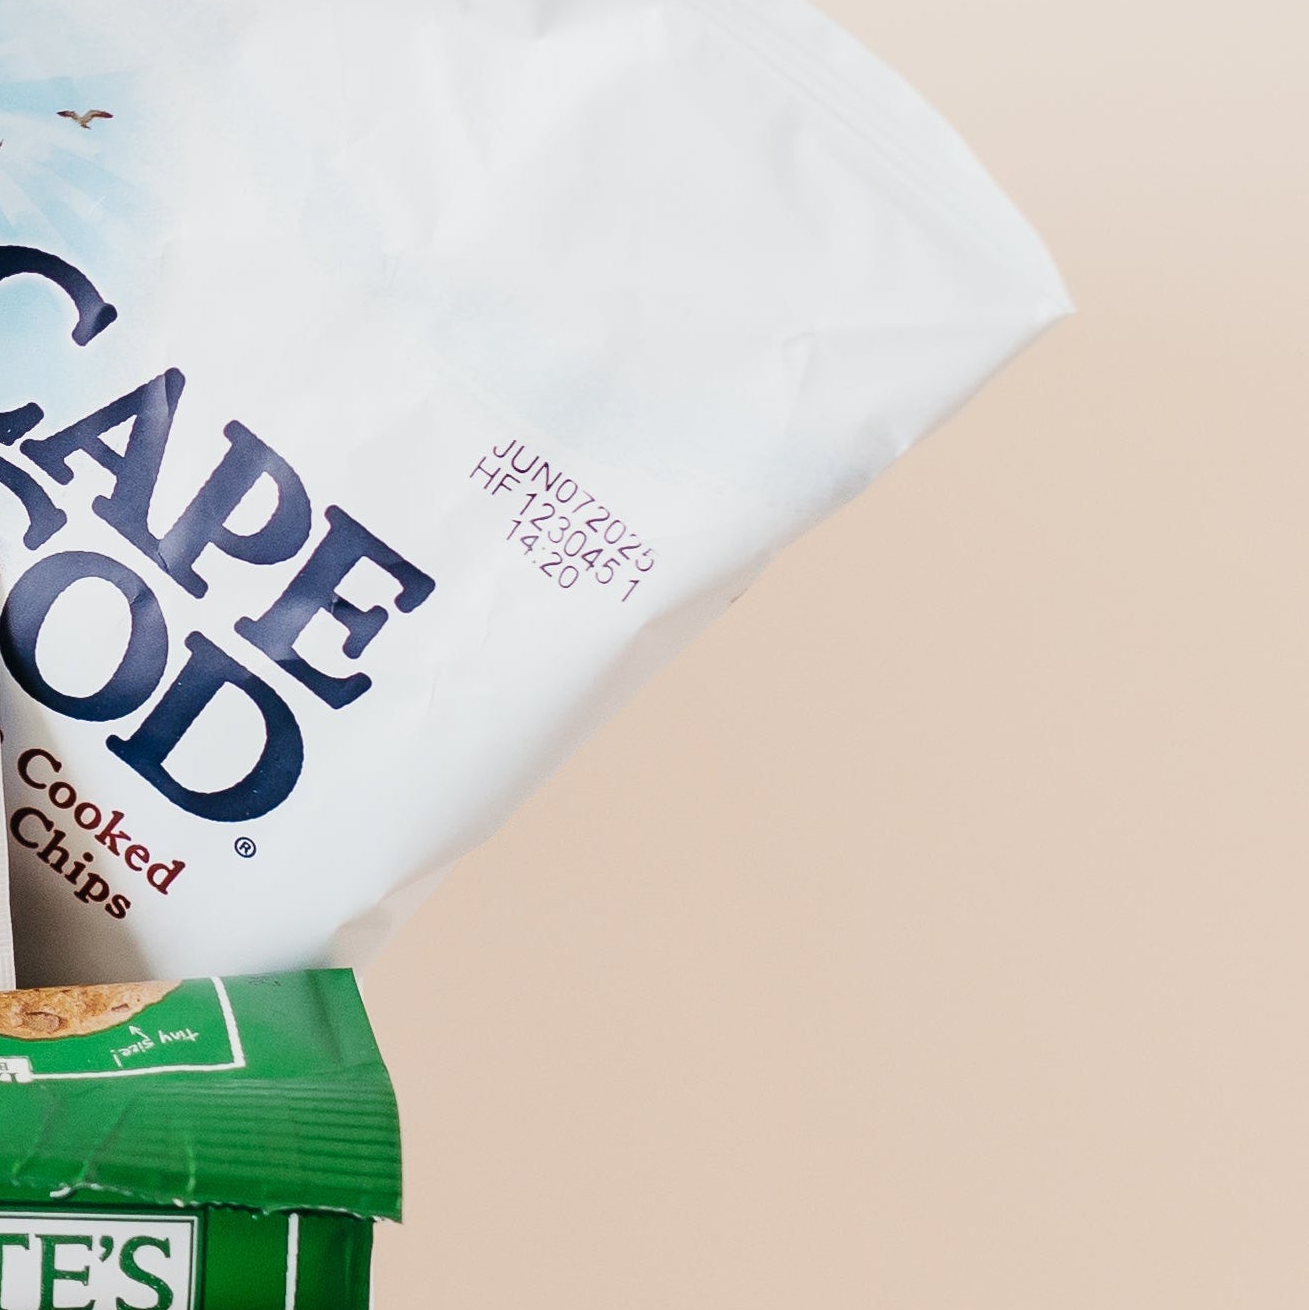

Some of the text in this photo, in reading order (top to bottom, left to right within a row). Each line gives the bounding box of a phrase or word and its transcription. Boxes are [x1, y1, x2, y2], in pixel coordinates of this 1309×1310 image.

[469, 457, 521, 495] HF
[520, 493, 620, 584] 123045
[506, 520, 579, 588] 14:20
[10, 807, 131, 919] Chips
[18, 749, 186, 895] Cooked
